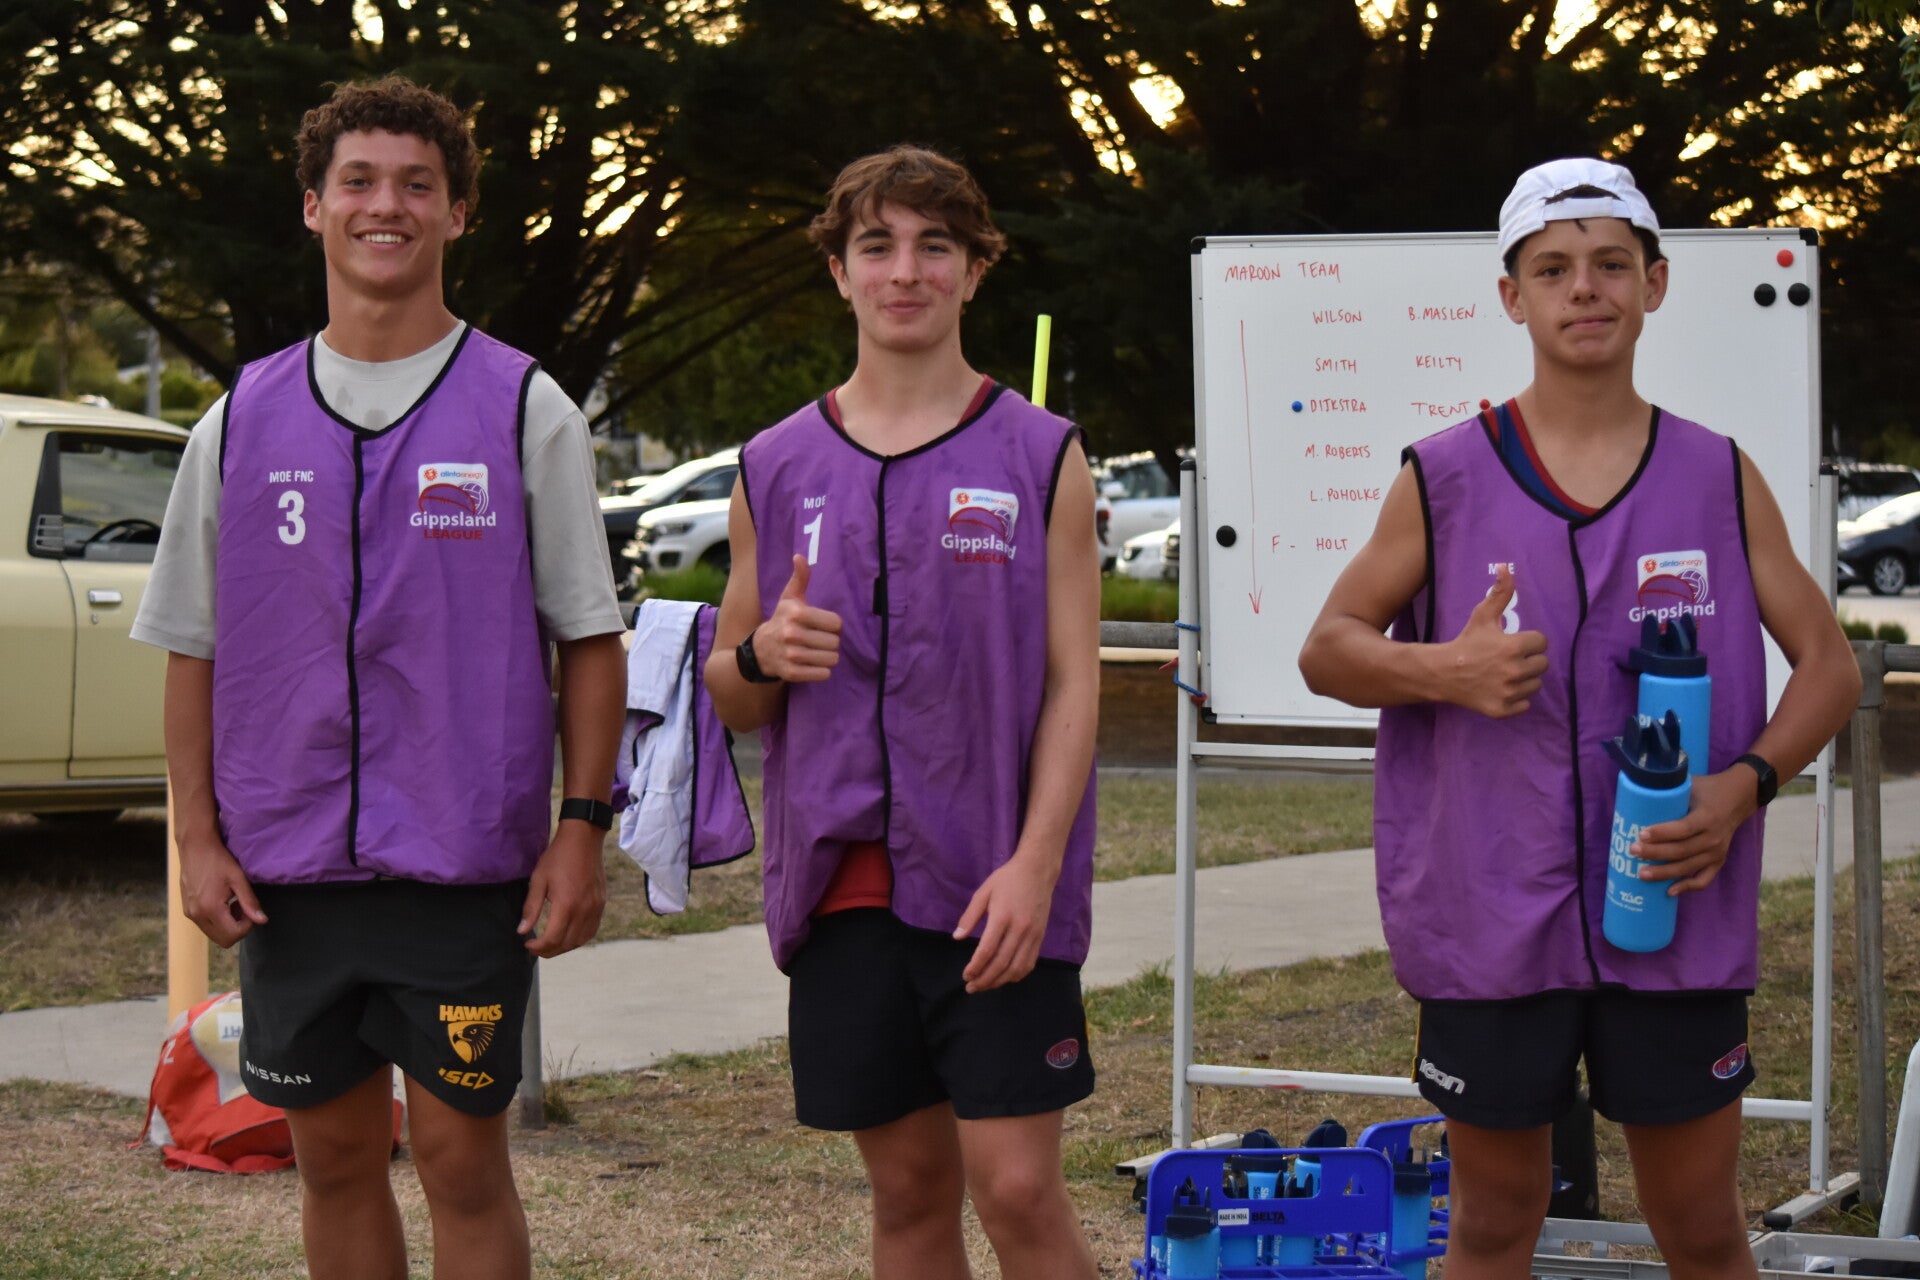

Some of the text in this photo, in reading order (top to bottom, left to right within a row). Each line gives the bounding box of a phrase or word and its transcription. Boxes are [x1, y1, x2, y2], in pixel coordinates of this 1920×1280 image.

[1225, 262, 1341, 283] MAROON TEAM
[1312, 309, 1362, 324] WILSON
[1315, 357, 1357, 374] SMITH
[1416, 355, 1462, 371] KEILTY
[1411, 401, 1471, 417] TRENT
[1325, 445, 1371, 459] ROBERTS
[269, 470, 314, 483] MOE FNC
[804, 495, 826, 509] MOE
[278, 490, 306, 545] 3
[410, 512, 497, 529] Gippsland
[423, 528, 483, 540] LEAGUE
[803, 512, 823, 566] 1
[941, 533, 1017, 560] Gippsland
[1272, 535, 1280, 553] F
[1316, 538, 1348, 551] HOLT
[954, 552, 1009, 566] LEAGUE
[1488, 563, 1515, 575] ME
[439, 1004, 503, 1021] HAWKS
[246, 1060, 312, 1085] NISSAN
[1251, 1212, 1285, 1223] BELTA
